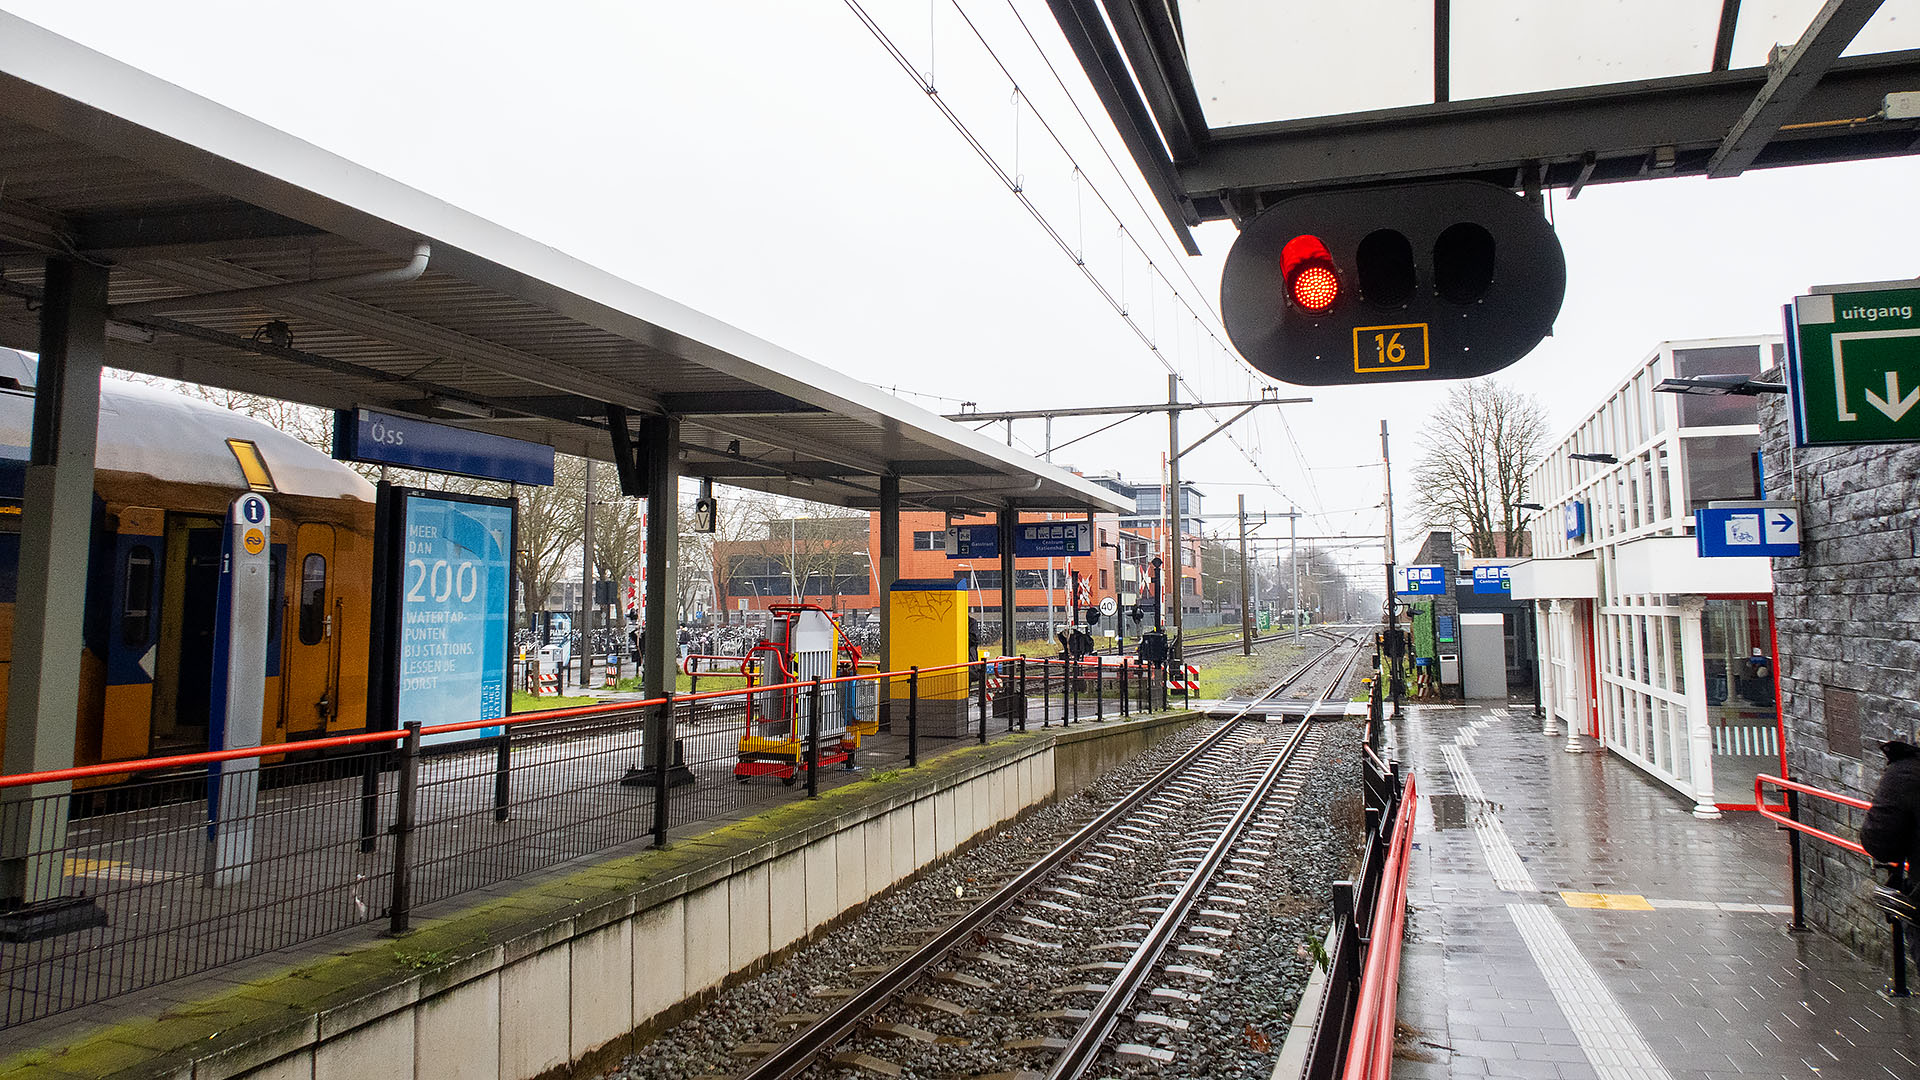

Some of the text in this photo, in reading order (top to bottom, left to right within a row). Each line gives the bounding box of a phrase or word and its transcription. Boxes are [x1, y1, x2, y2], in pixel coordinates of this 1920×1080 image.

[1842, 306, 1912, 321] uitgang
[1375, 332, 1406, 363] 16
[371, 421, 404, 445] Oss
[697, 513, 708, 528] V
[409, 524, 438, 538] MEER
[408, 541, 432, 554] DAN
[407, 559, 477, 603] 200
[406, 611, 467, 624] WATERTAP-
[405, 627, 446, 641] PUNTEN
[404, 643, 474, 657] BIJ STATIONS.
[404, 659, 456, 674] LESSEN JE
[403, 676, 438, 691] DORST
